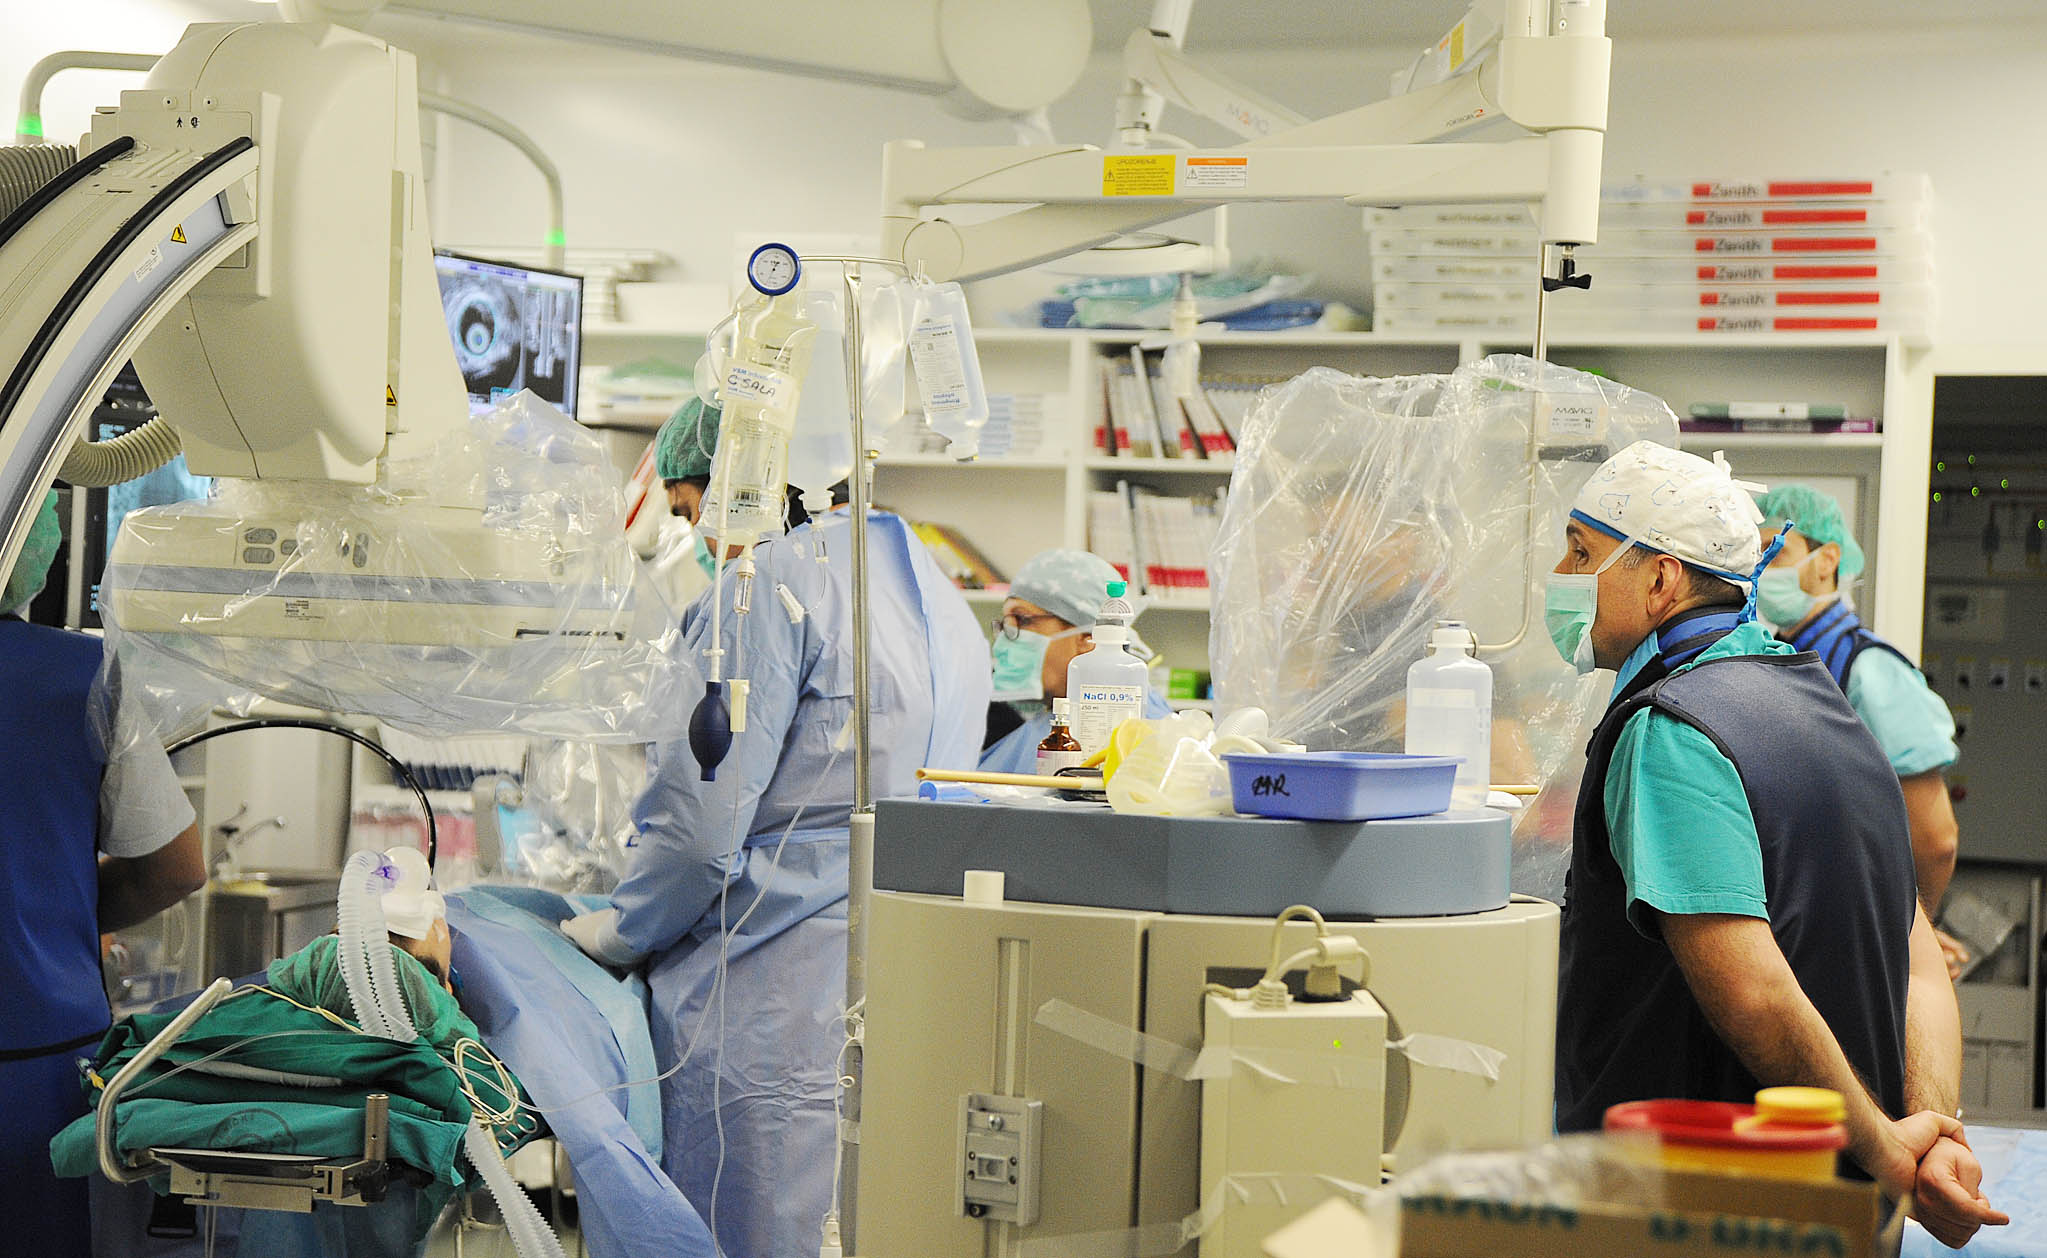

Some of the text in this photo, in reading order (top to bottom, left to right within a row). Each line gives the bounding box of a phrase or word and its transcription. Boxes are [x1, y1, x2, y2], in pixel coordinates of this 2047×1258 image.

[1711, 183, 1759, 197] Zenith
[1705, 211, 1752, 224] Zenith
[1715, 239, 1761, 251] Zenith
[1716, 266, 1761, 279] Zenith
[1718, 293, 1764, 305] Zenith
[1716, 318, 1763, 330] Zenith
[1555, 407, 1593, 415] MAVIG
[1083, 692, 1134, 702] NaCl 0,9%
